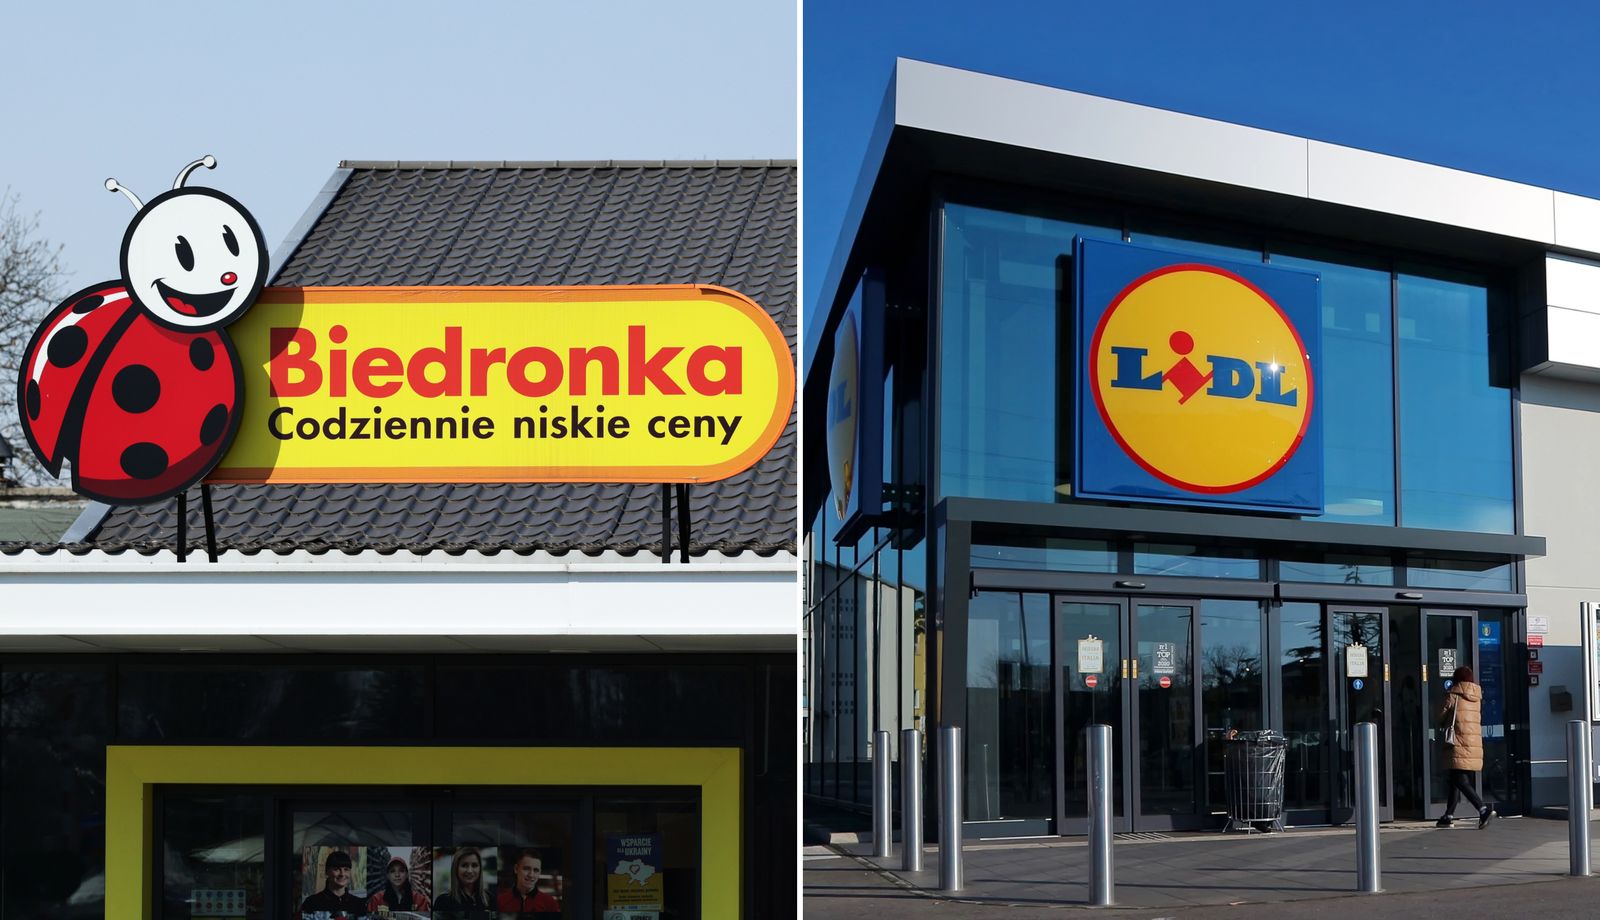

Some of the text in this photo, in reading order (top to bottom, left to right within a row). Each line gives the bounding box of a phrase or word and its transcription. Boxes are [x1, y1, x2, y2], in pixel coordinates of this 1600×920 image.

[270, 325, 742, 398] Biedronka
[268, 404, 743, 446] Codziennie niskie ceny
[621, 838, 651, 847] WSPARCIE
